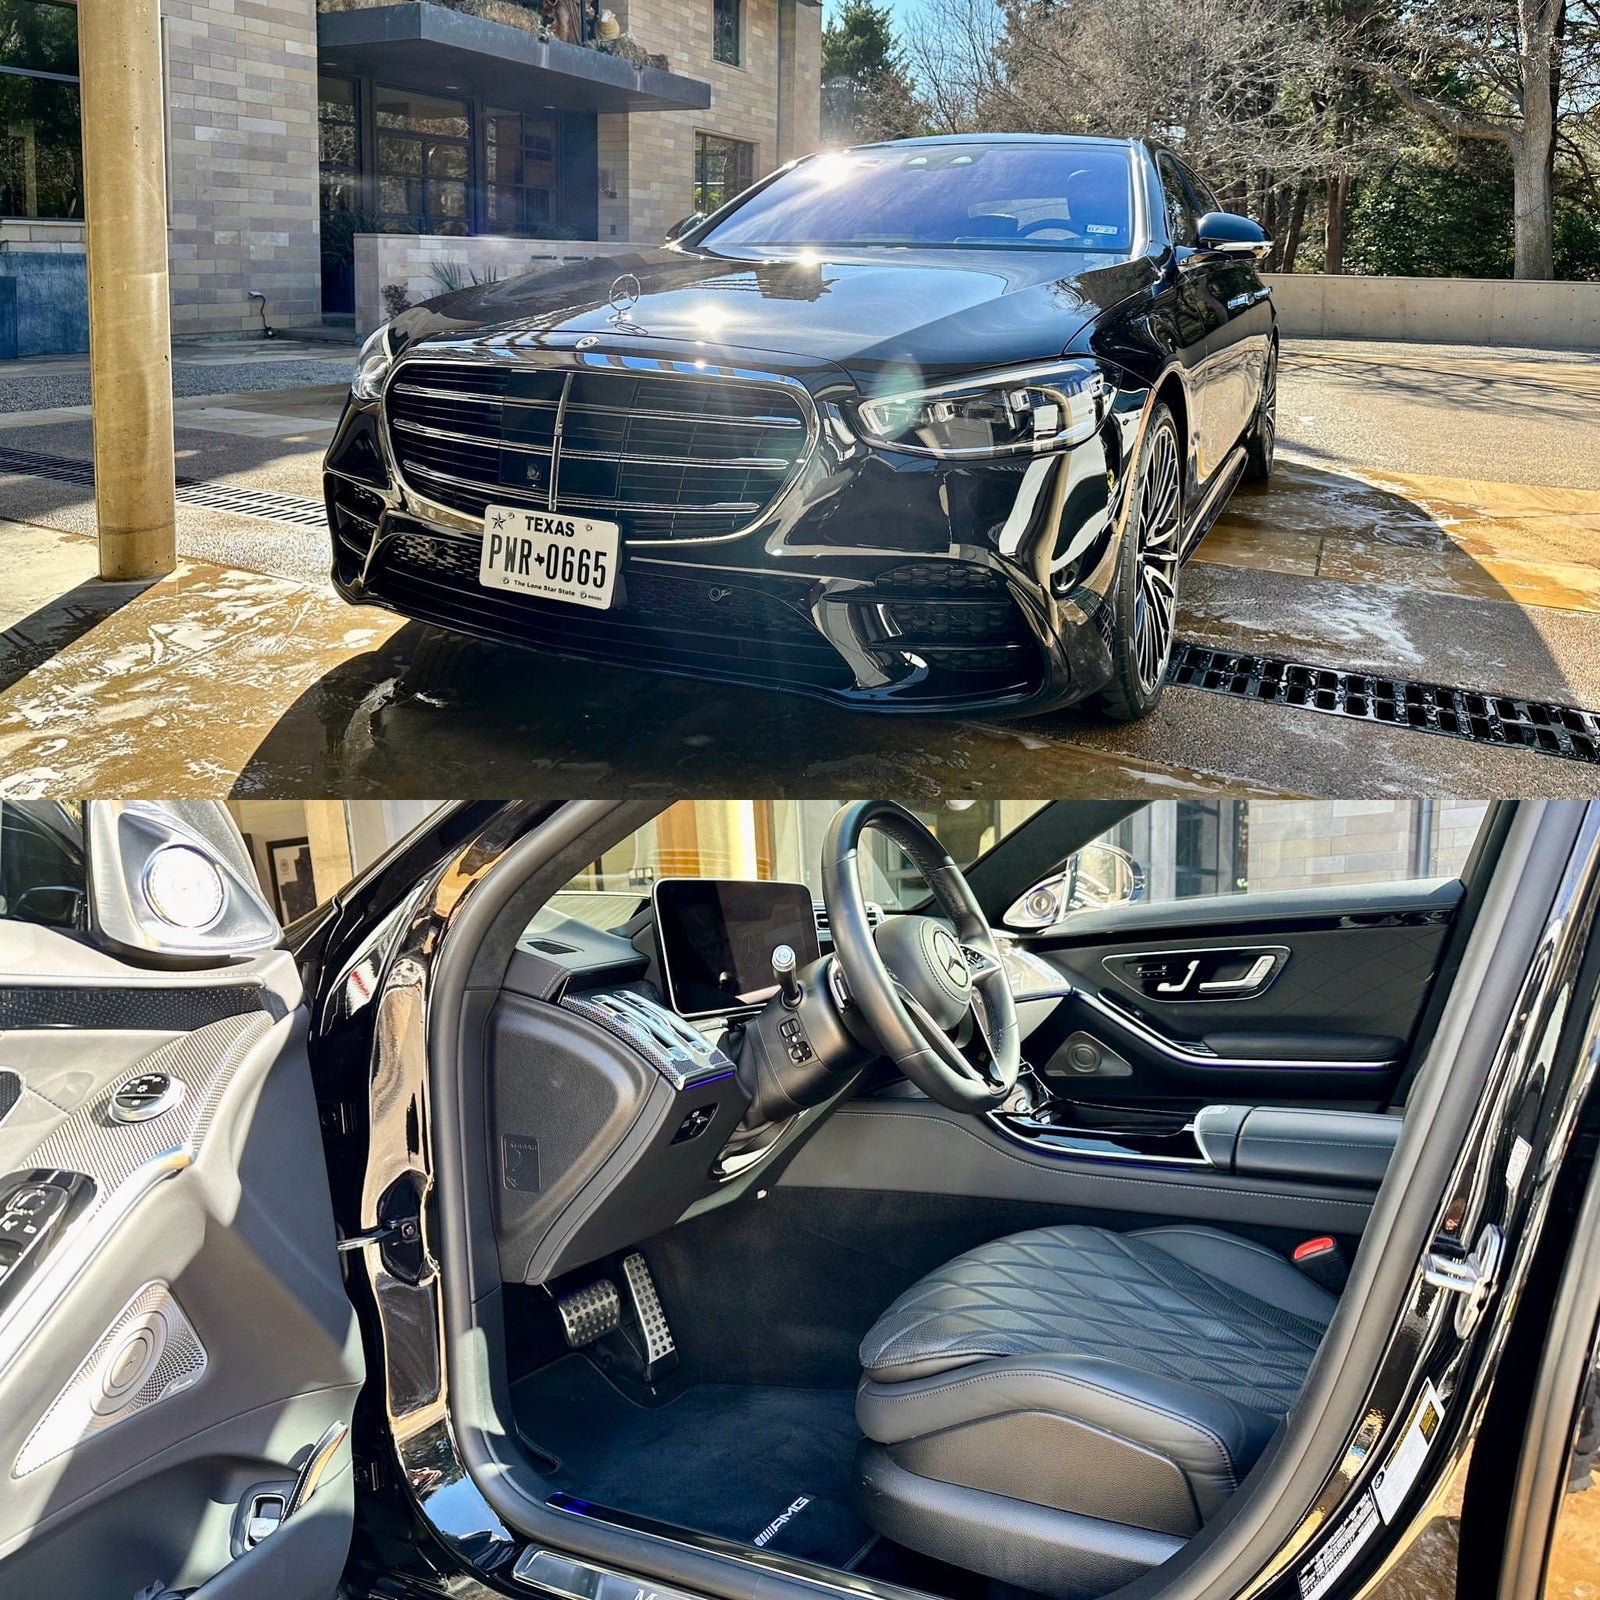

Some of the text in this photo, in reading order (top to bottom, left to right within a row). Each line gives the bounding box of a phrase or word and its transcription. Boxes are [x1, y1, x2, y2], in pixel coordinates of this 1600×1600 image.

[525, 515, 575, 537] TEXAS
[488, 533, 607, 589] PWR 0665
[527, 582, 542, 590] Lone
[543, 585, 557, 593] Star
[558, 588, 576, 596] State
